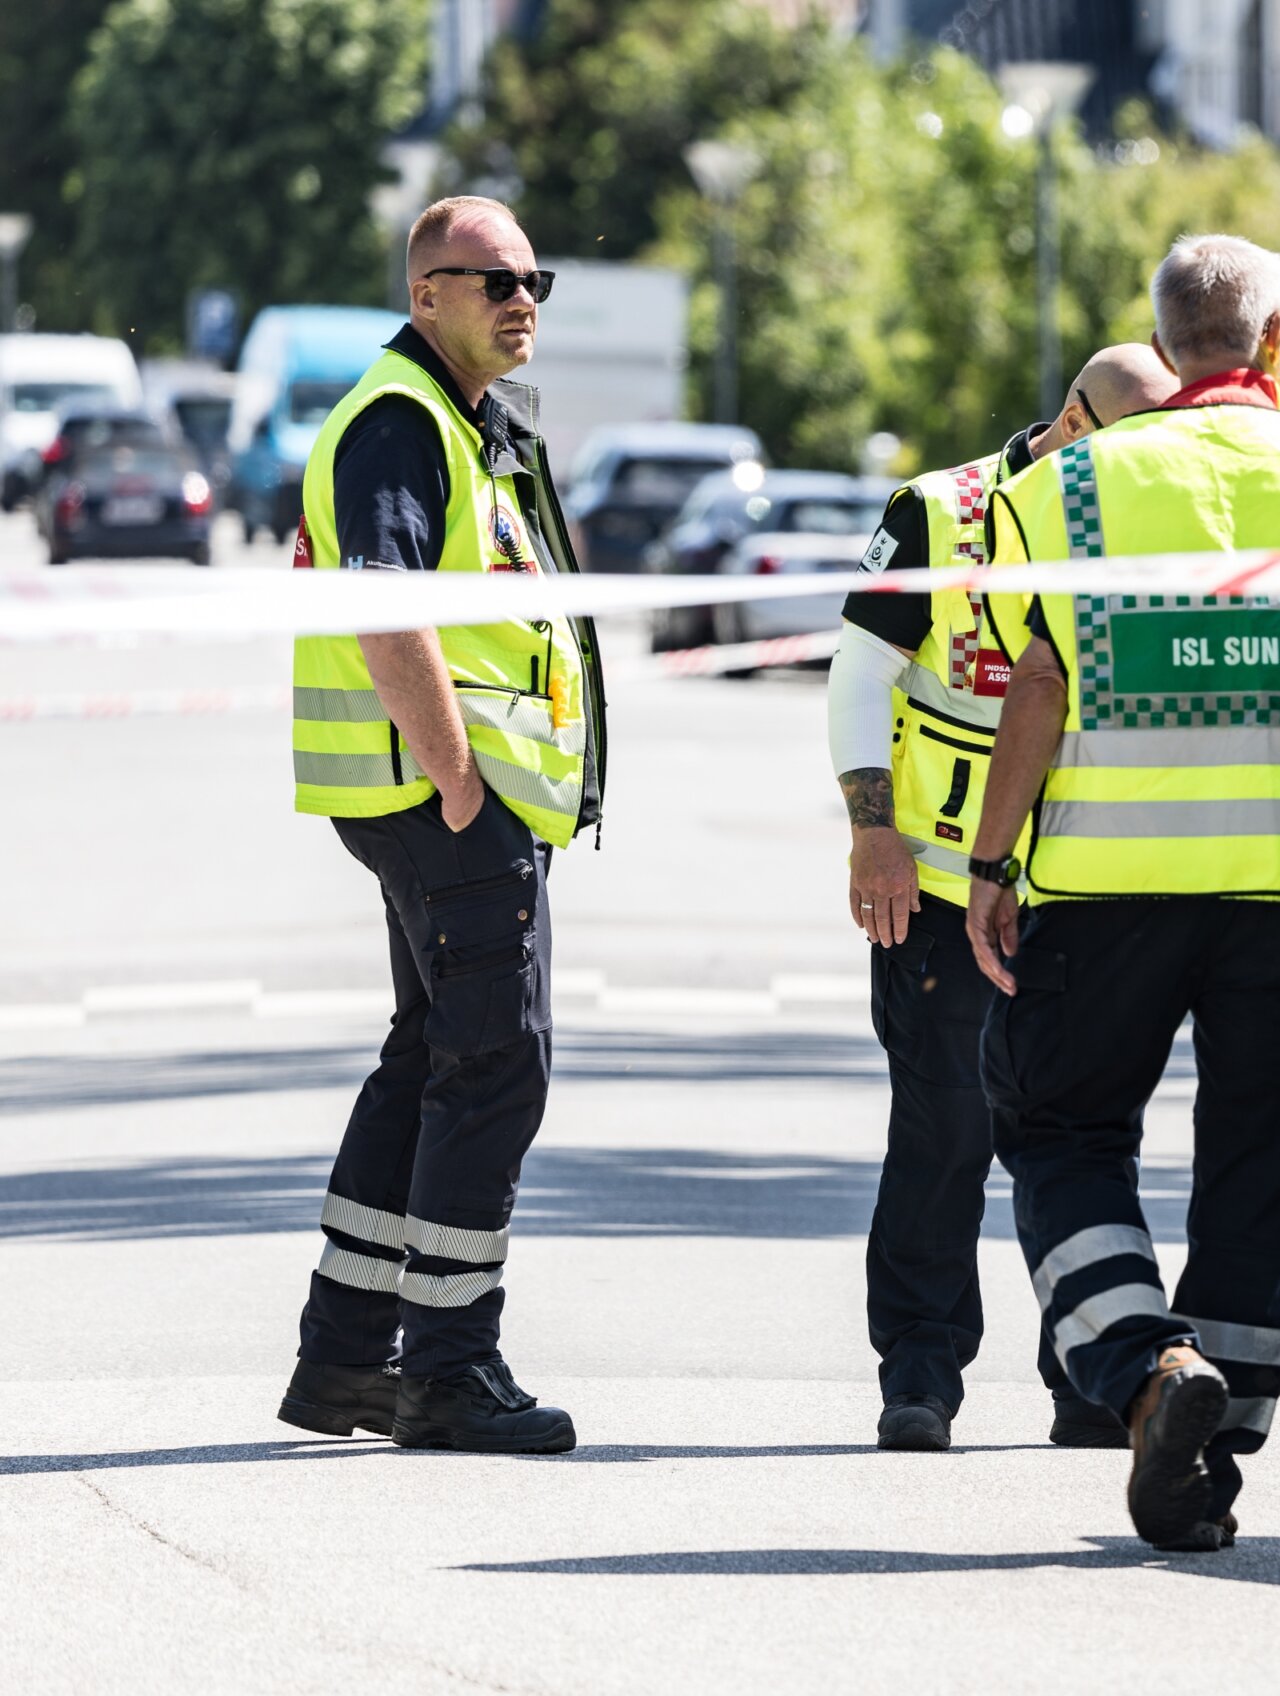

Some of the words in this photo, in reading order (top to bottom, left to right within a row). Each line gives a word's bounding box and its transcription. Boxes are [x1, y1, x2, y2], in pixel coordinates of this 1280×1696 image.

[1172, 637, 1215, 667] ISL
[984, 664, 1011, 673] INDSA
[987, 672, 1010, 683] ASSI
